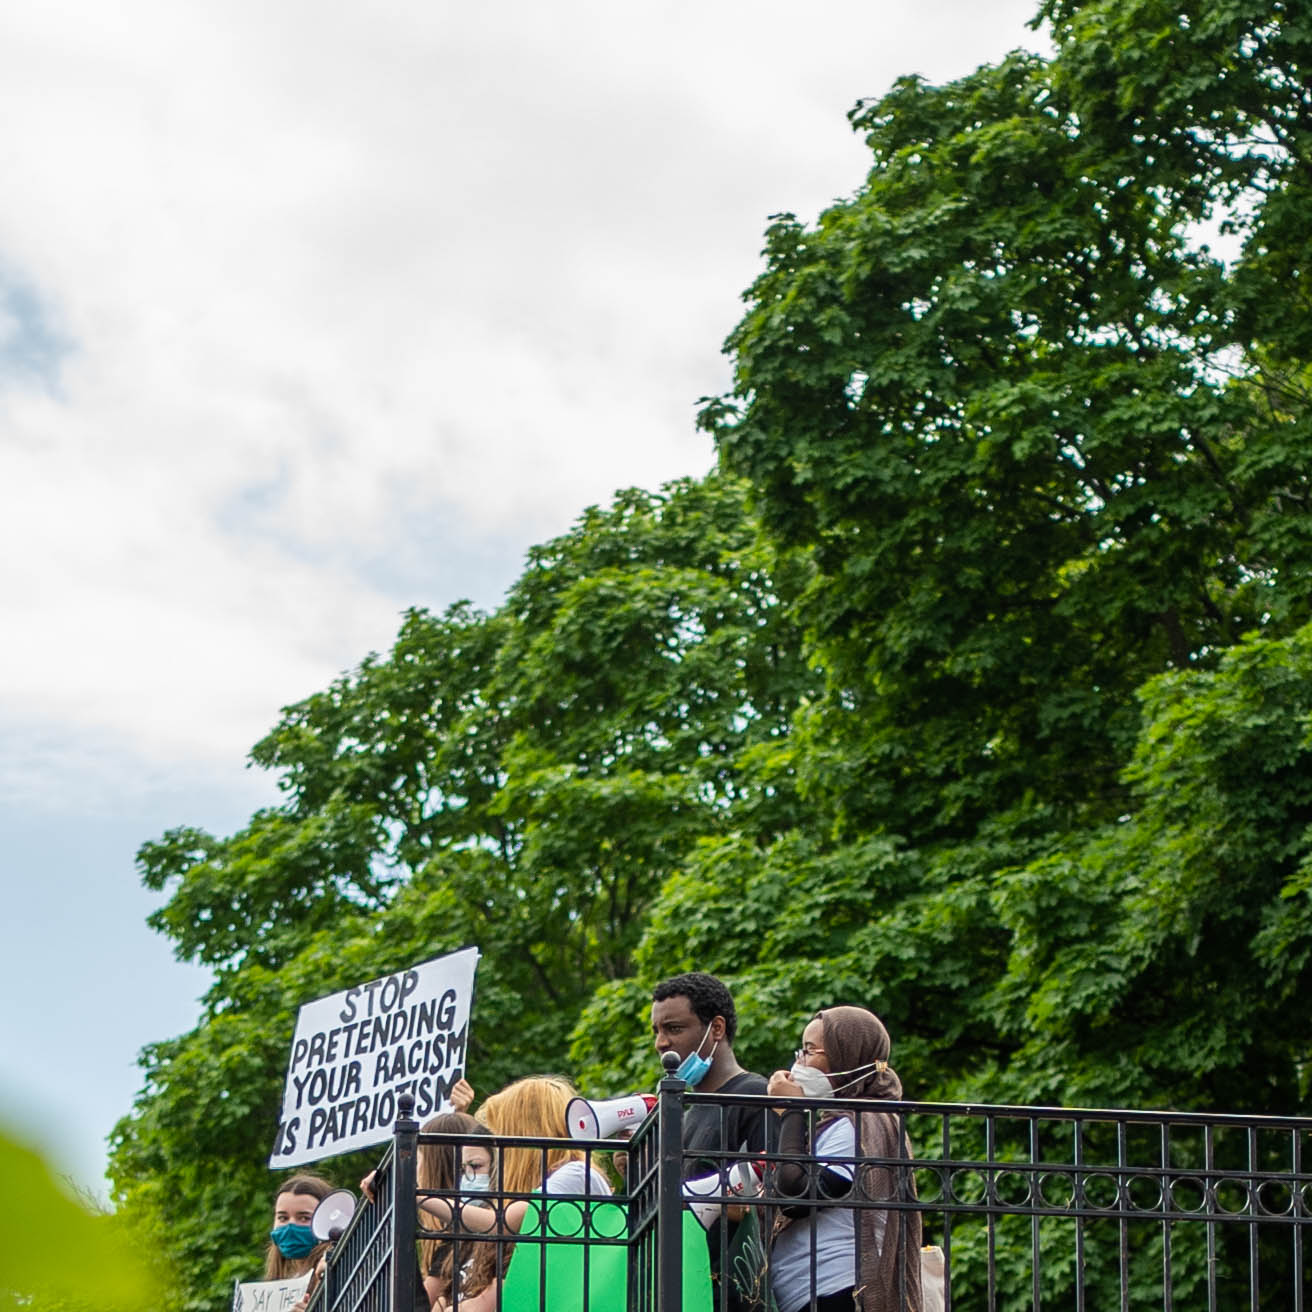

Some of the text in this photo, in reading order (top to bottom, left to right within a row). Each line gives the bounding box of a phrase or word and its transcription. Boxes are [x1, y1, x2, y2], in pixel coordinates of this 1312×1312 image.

[339, 970, 419, 1023] STOP
[291, 988, 456, 1073] PRETENDING
[293, 1021, 467, 1109] YOUR RACISM
[273, 1117, 300, 1156] IS
[617, 1107, 635, 1118] PYLE
